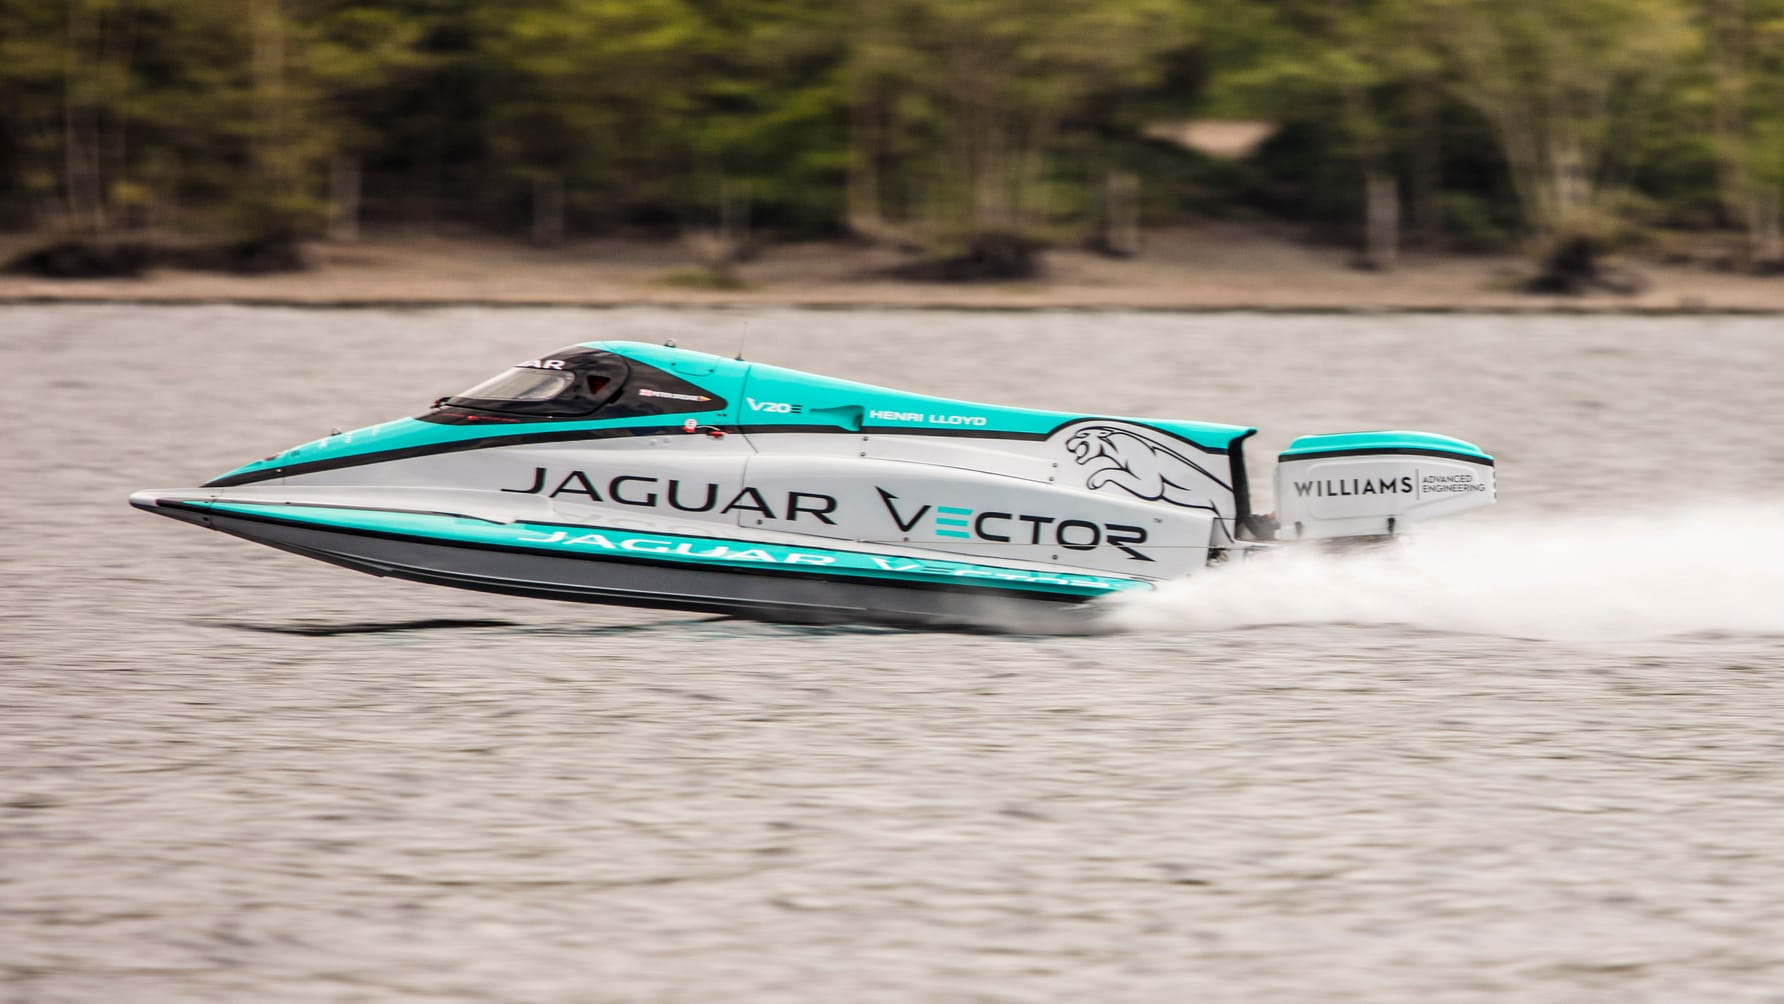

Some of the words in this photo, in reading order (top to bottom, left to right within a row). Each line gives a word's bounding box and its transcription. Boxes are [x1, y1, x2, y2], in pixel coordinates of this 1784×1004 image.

[869, 409, 923, 422] HENRI
[928, 413, 987, 426] LLOYD
[1294, 476, 1413, 497] WILLIAMS
[1422, 483, 1486, 493] ENGINEERING
[1423, 474, 1473, 484] ADVANCED
[500, 467, 838, 525] JAGUAR
[875, 486, 1156, 562] VECTOR
[519, 532, 837, 566] JAGUAR
